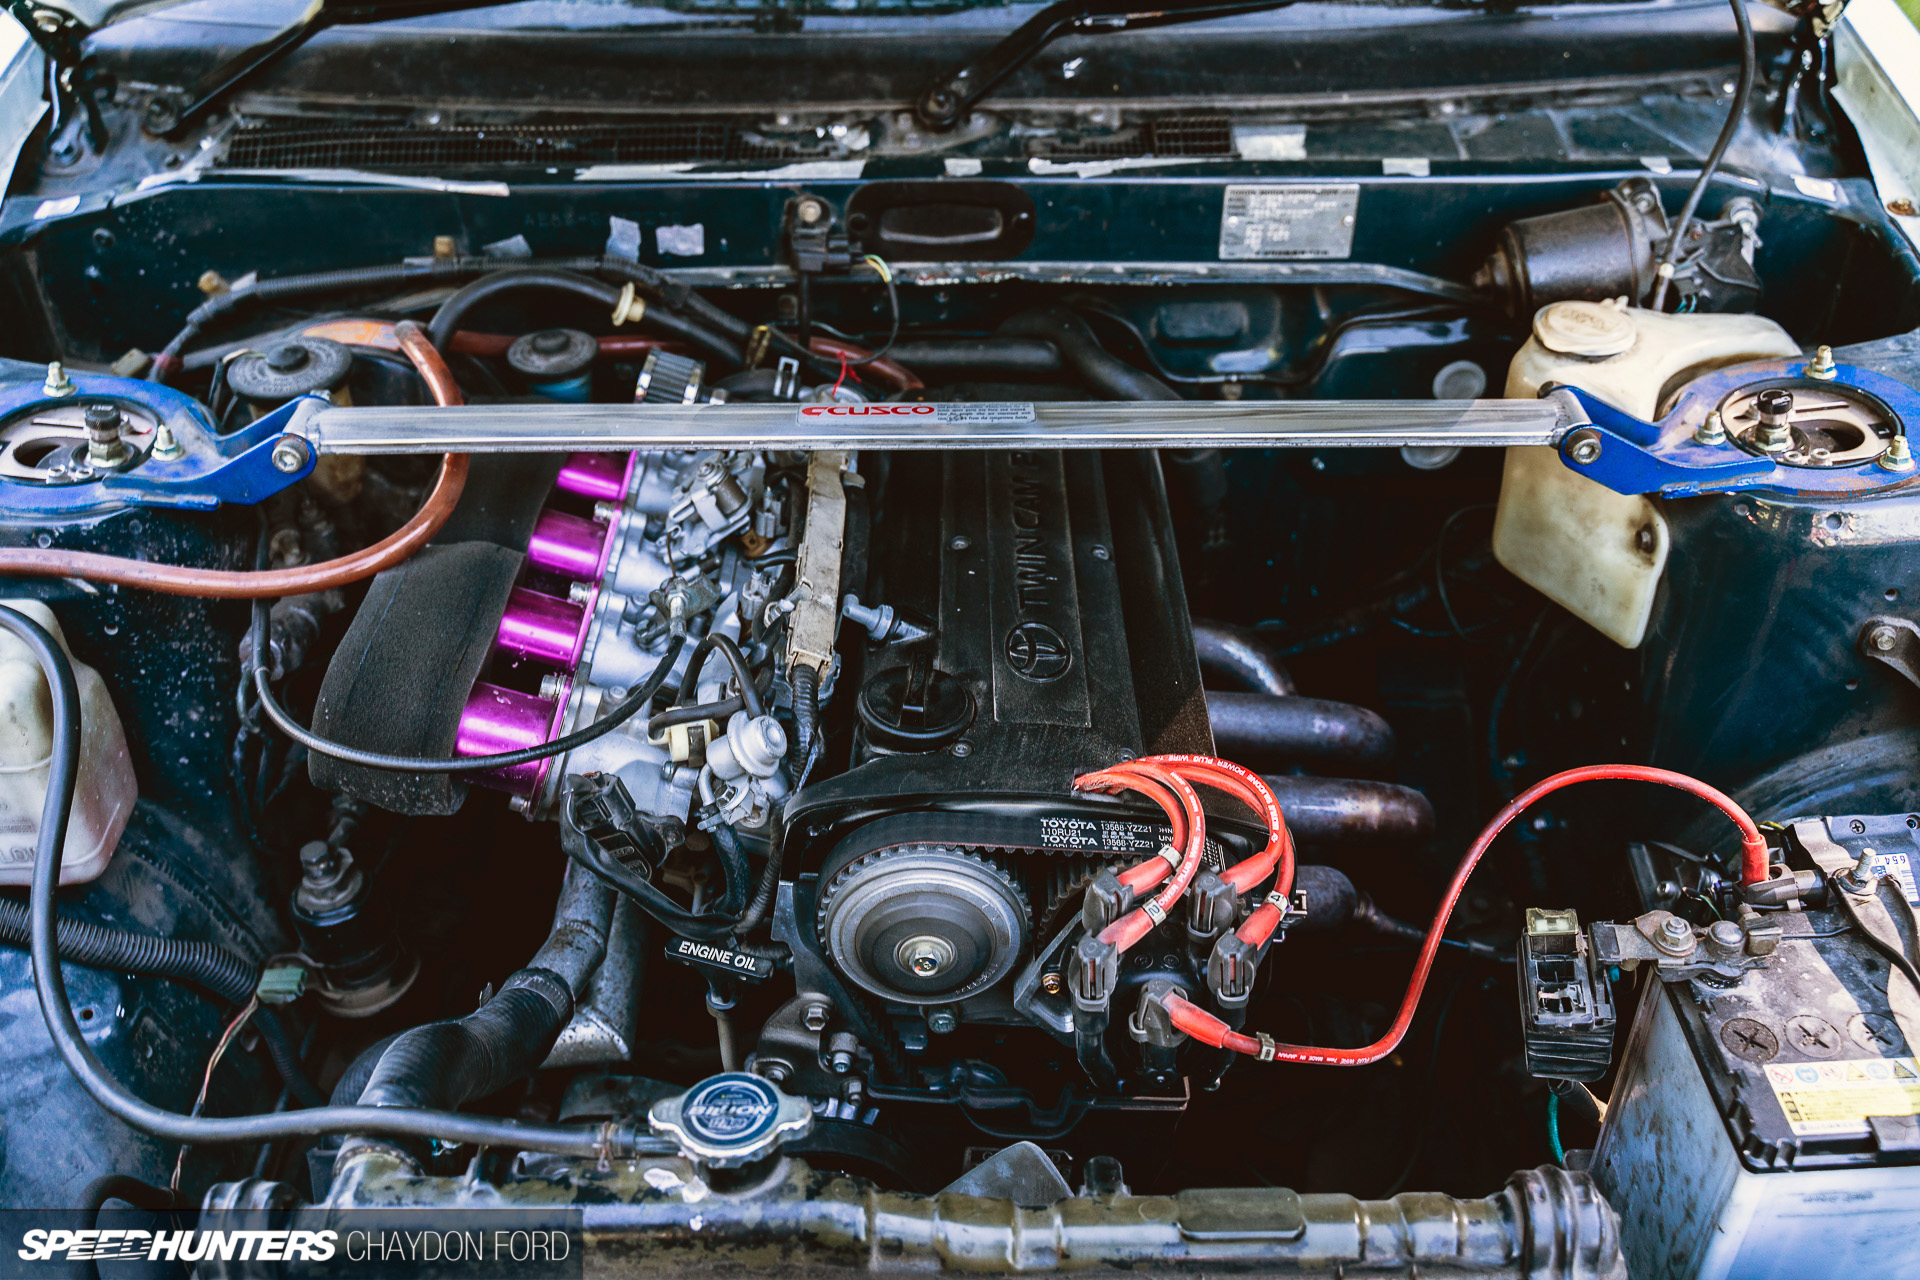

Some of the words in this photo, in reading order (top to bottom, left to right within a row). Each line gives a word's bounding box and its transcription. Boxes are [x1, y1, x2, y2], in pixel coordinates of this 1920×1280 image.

[827, 405, 936, 416] CUSCO
[1168, 754, 1189, 762] WIRE
[1193, 755, 1213, 764] PLUG
[1217, 760, 1245, 776] POWER
[1247, 774, 1273, 805] SILICONE
[1040, 818, 1097, 831] TOYOTA
[1041, 827, 1081, 837] 110RU21
[1041, 833, 1098, 846] TOYOTA
[1158, 883, 1179, 906] OWER
[1177, 861, 1192, 883] PLUG
[1189, 836, 1201, 858] WIRE
[678, 940, 733, 964] ENGINE
[734, 954, 756, 971] OIL
[1277, 1052, 1298, 1060] JAPAN
[687, 1103, 774, 1116] BILLION
